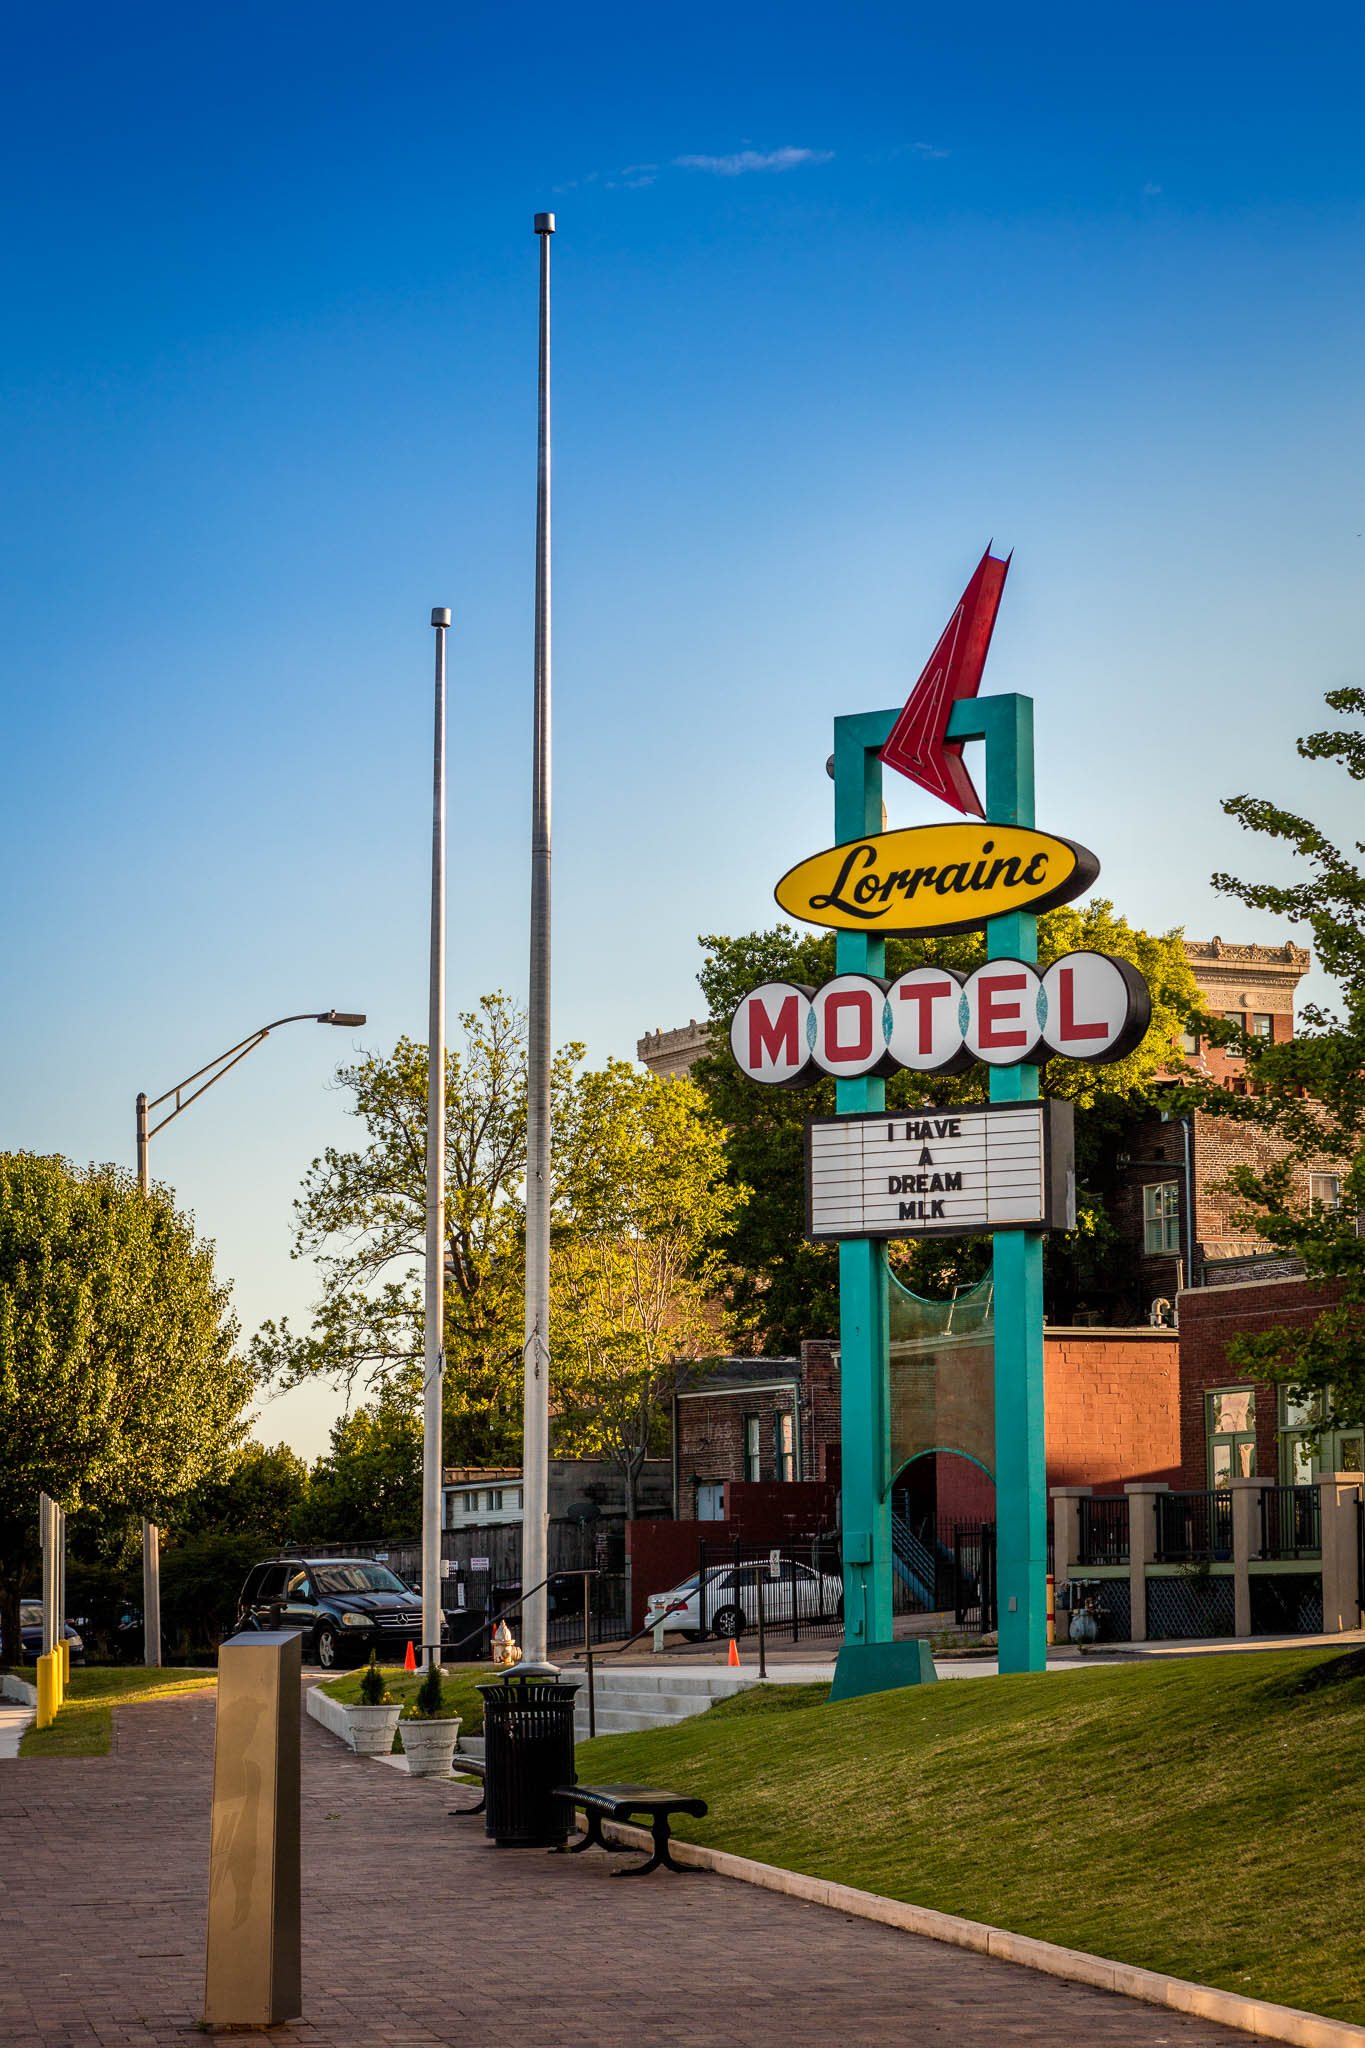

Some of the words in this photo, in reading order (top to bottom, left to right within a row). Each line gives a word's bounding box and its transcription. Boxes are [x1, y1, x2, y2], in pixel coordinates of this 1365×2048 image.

[809, 841, 1049, 919] Lorraine
[748, 968, 1109, 1070] MOTEL
[887, 1122, 894, 1142] I
[906, 1118, 961, 1140] HAVE
[918, 1146, 934, 1166] A
[888, 1172, 962, 1195] DREAM
[899, 1199, 945, 1220] MLK
